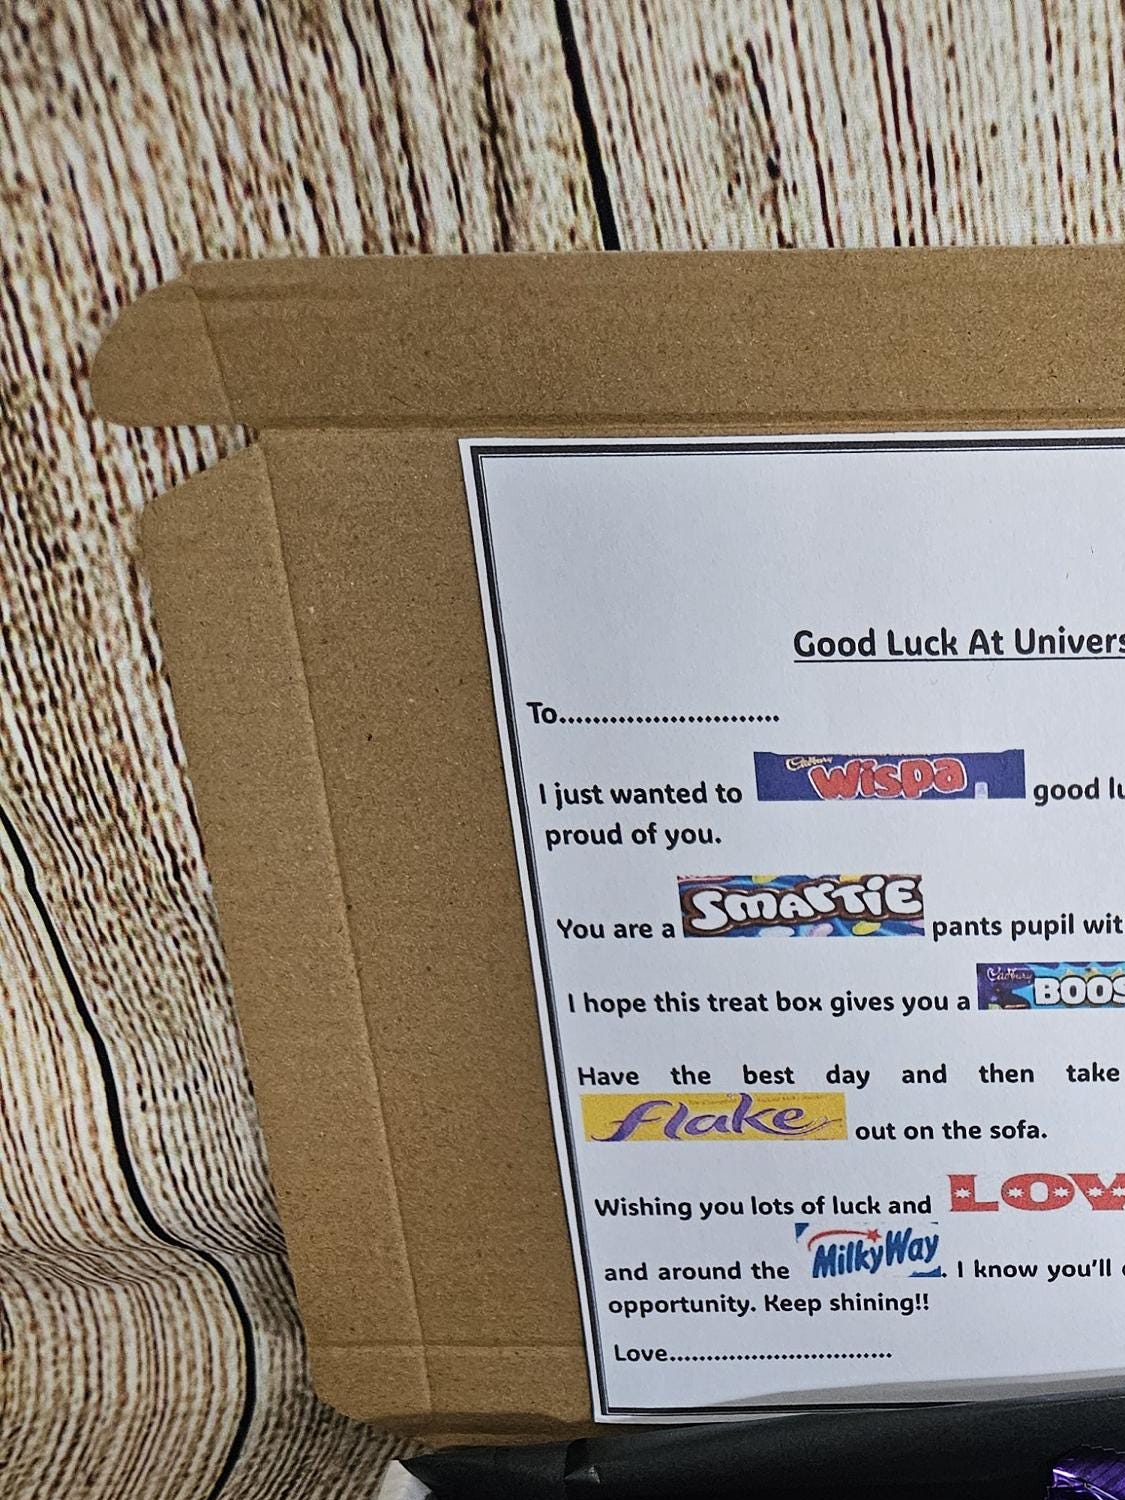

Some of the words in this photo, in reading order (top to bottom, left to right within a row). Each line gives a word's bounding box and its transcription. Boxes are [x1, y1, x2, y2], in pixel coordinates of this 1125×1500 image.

[793, 628, 876, 658] Good
[887, 627, 958, 657] Luck
[968, 628, 1004, 656] At
[538, 782, 547, 805] I
[553, 781, 605, 812] just
[609, 780, 708, 805] wanted
[714, 783, 743, 804] to
[808, 757, 967, 801] Wispa
[1033, 776, 1100, 807] good
[544, 821, 624, 852] proud
[630, 821, 658, 846] of
[664, 827, 722, 851] you.
[556, 918, 606, 940] You
[613, 922, 654, 939] are
[661, 922, 676, 939] a
[932, 916, 1003, 943] pants
[1011, 912, 1075, 942] pupil
[567, 992, 576, 1014] I
[583, 991, 647, 1019] hope
[653, 990, 701, 1013] this
[706, 993, 770, 1013] treat
[775, 990, 823, 1012] box
[830, 990, 895, 1018] gives
[901, 995, 949, 1017] you
[956, 995, 971, 1011] a
[577, 1066, 640, 1086] Have
[669, 1064, 712, 1086] the
[742, 1063, 796, 1085] best
[825, 1063, 871, 1090] day
[901, 1062, 947, 1084] and
[978, 1062, 1035, 1084] then
[1065, 1061, 1120, 1083] take
[855, 1122, 897, 1141] out
[903, 1125, 935, 1141] on
[941, 1119, 982, 1140] the
[989, 1119, 1048, 1140] sofa.
[594, 1196, 693, 1221] Wishing
[699, 1201, 745, 1221] you
[750, 1195, 795, 1216] lots
[800, 1195, 826, 1215] of
[832, 1194, 882, 1215] luck
[888, 1194, 932, 1215] and
[604, 1261, 649, 1282] and
[658, 1260, 742, 1281] around
[750, 1260, 790, 1280] the
[957, 1260, 964, 1278] I
[973, 1258, 1038, 1278] know
[1047, 1257, 1112, 1283] you'll
[608, 1293, 757, 1319] opportunity.
[764, 1293, 822, 1317] Keep
[829, 1292, 930, 1317] shining!!
